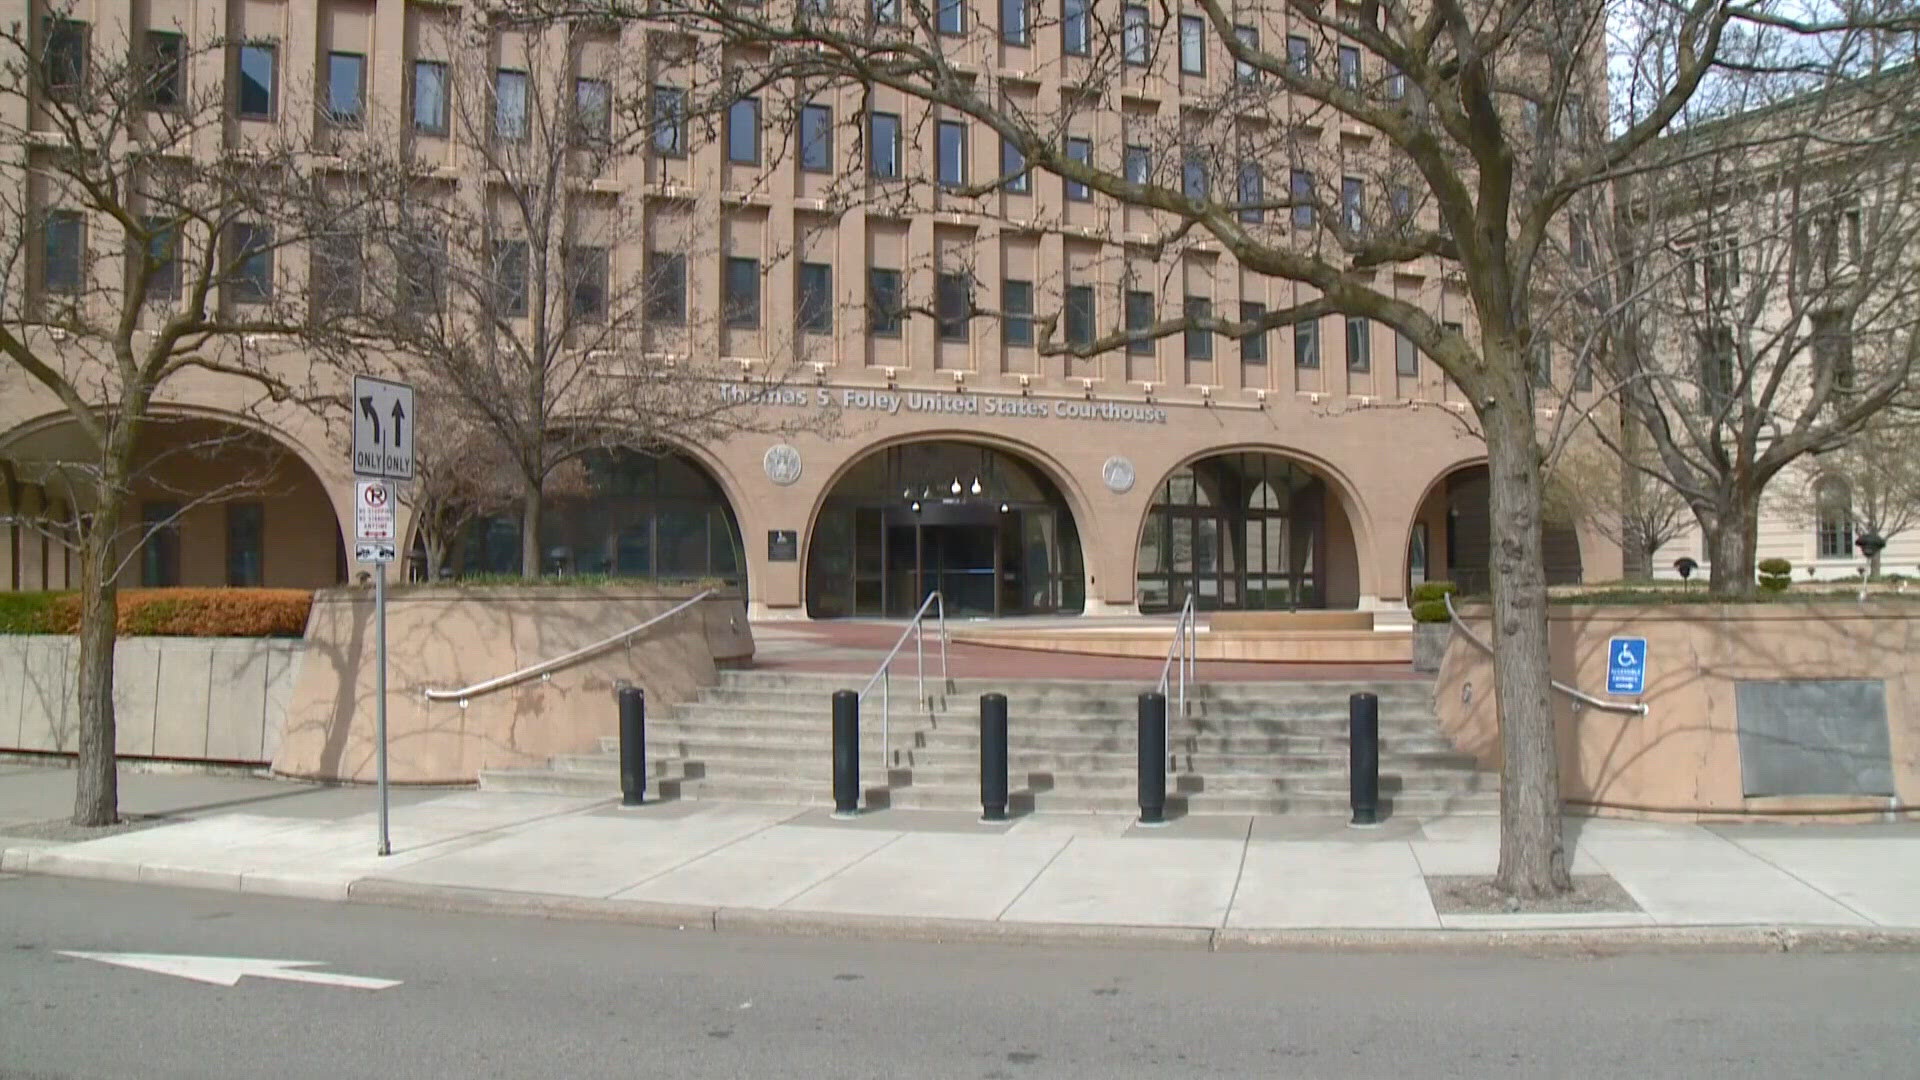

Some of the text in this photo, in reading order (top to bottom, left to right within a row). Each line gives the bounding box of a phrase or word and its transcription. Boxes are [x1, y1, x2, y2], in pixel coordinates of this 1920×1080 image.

[719, 383, 808, 407] Thomas
[843, 389, 902, 416] Foley
[908, 393, 977, 413] United
[985, 397, 1048, 418] States
[1055, 400, 1168, 424] Courthouse
[357, 451, 381, 469] ONLY
[386, 454, 410, 473] ONLY
